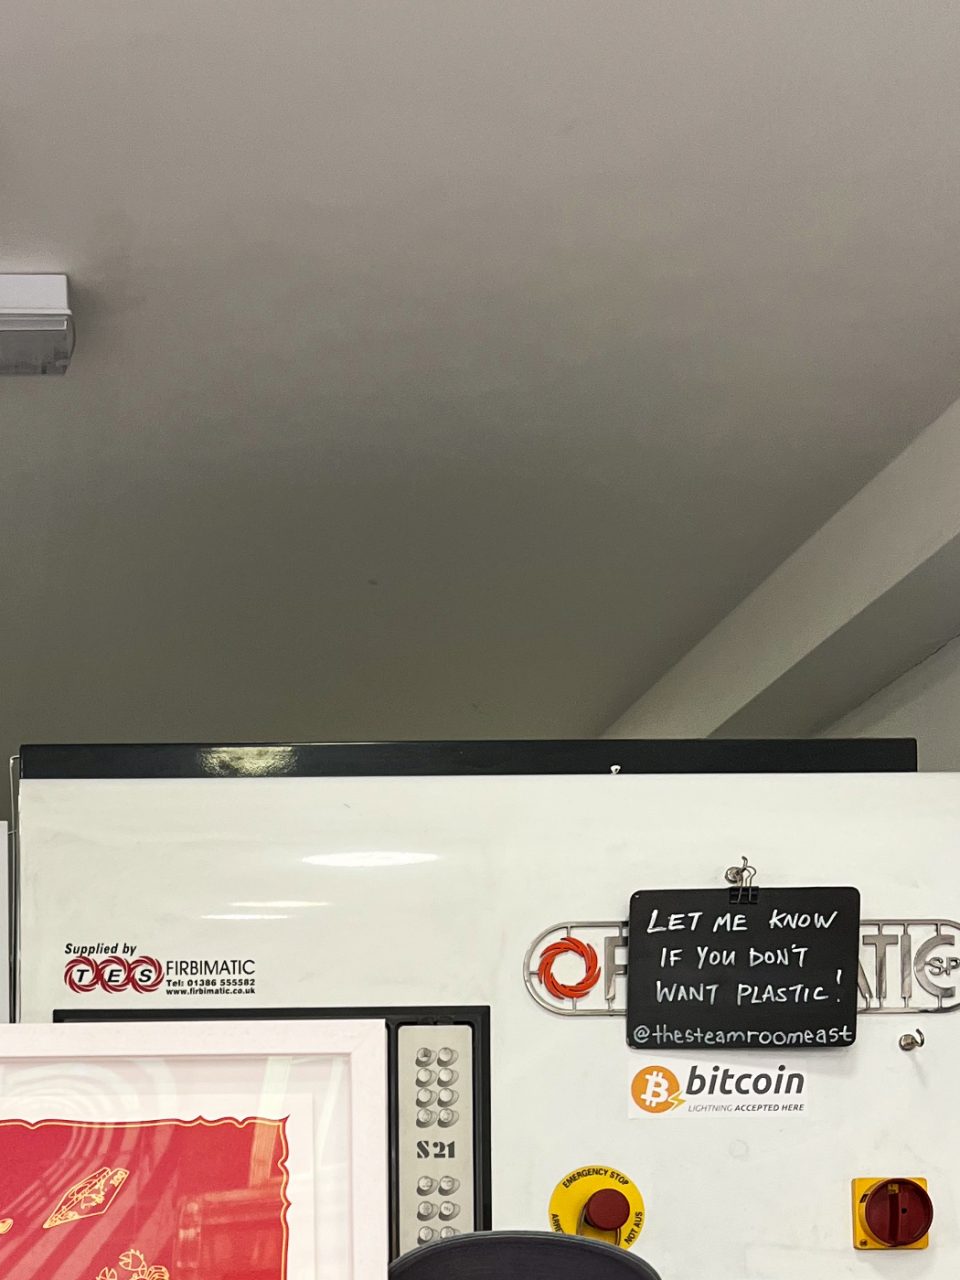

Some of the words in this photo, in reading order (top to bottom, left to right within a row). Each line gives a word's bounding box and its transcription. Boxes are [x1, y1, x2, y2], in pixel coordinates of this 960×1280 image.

[646, 909, 703, 934] LET
[712, 913, 748, 932] ME
[768, 909, 838, 930] KNOW
[64, 943, 119, 957] Supplied
[122, 945, 137, 956] by
[660, 947, 683, 967] IF
[697, 946, 736, 969] YOU
[749, 944, 809, 968] DON'T
[166, 959, 256, 976] FIRBIMATIC
[166, 979, 184, 987] Tel:
[187, 979, 217, 987] 01386
[219, 978, 256, 987] 555582
[166, 987, 256, 996] www.firbimatic.co.uk
[656, 980, 719, 1005] WANT
[633, 1024, 853, 1044] @thesteamroomeast
[685, 1064, 805, 1096] bitcoin
[687, 1104, 733, 1113] LIGHTNING
[734, 1104, 780, 1112] ACCEPTED
[781, 1103, 805, 1112] HERE
[562, 1167, 609, 1189] EMERGENCY
[609, 1171, 629, 1186] STOP
[624, 1227, 638, 1245] NOT
[634, 1211, 643, 1228] AUS
